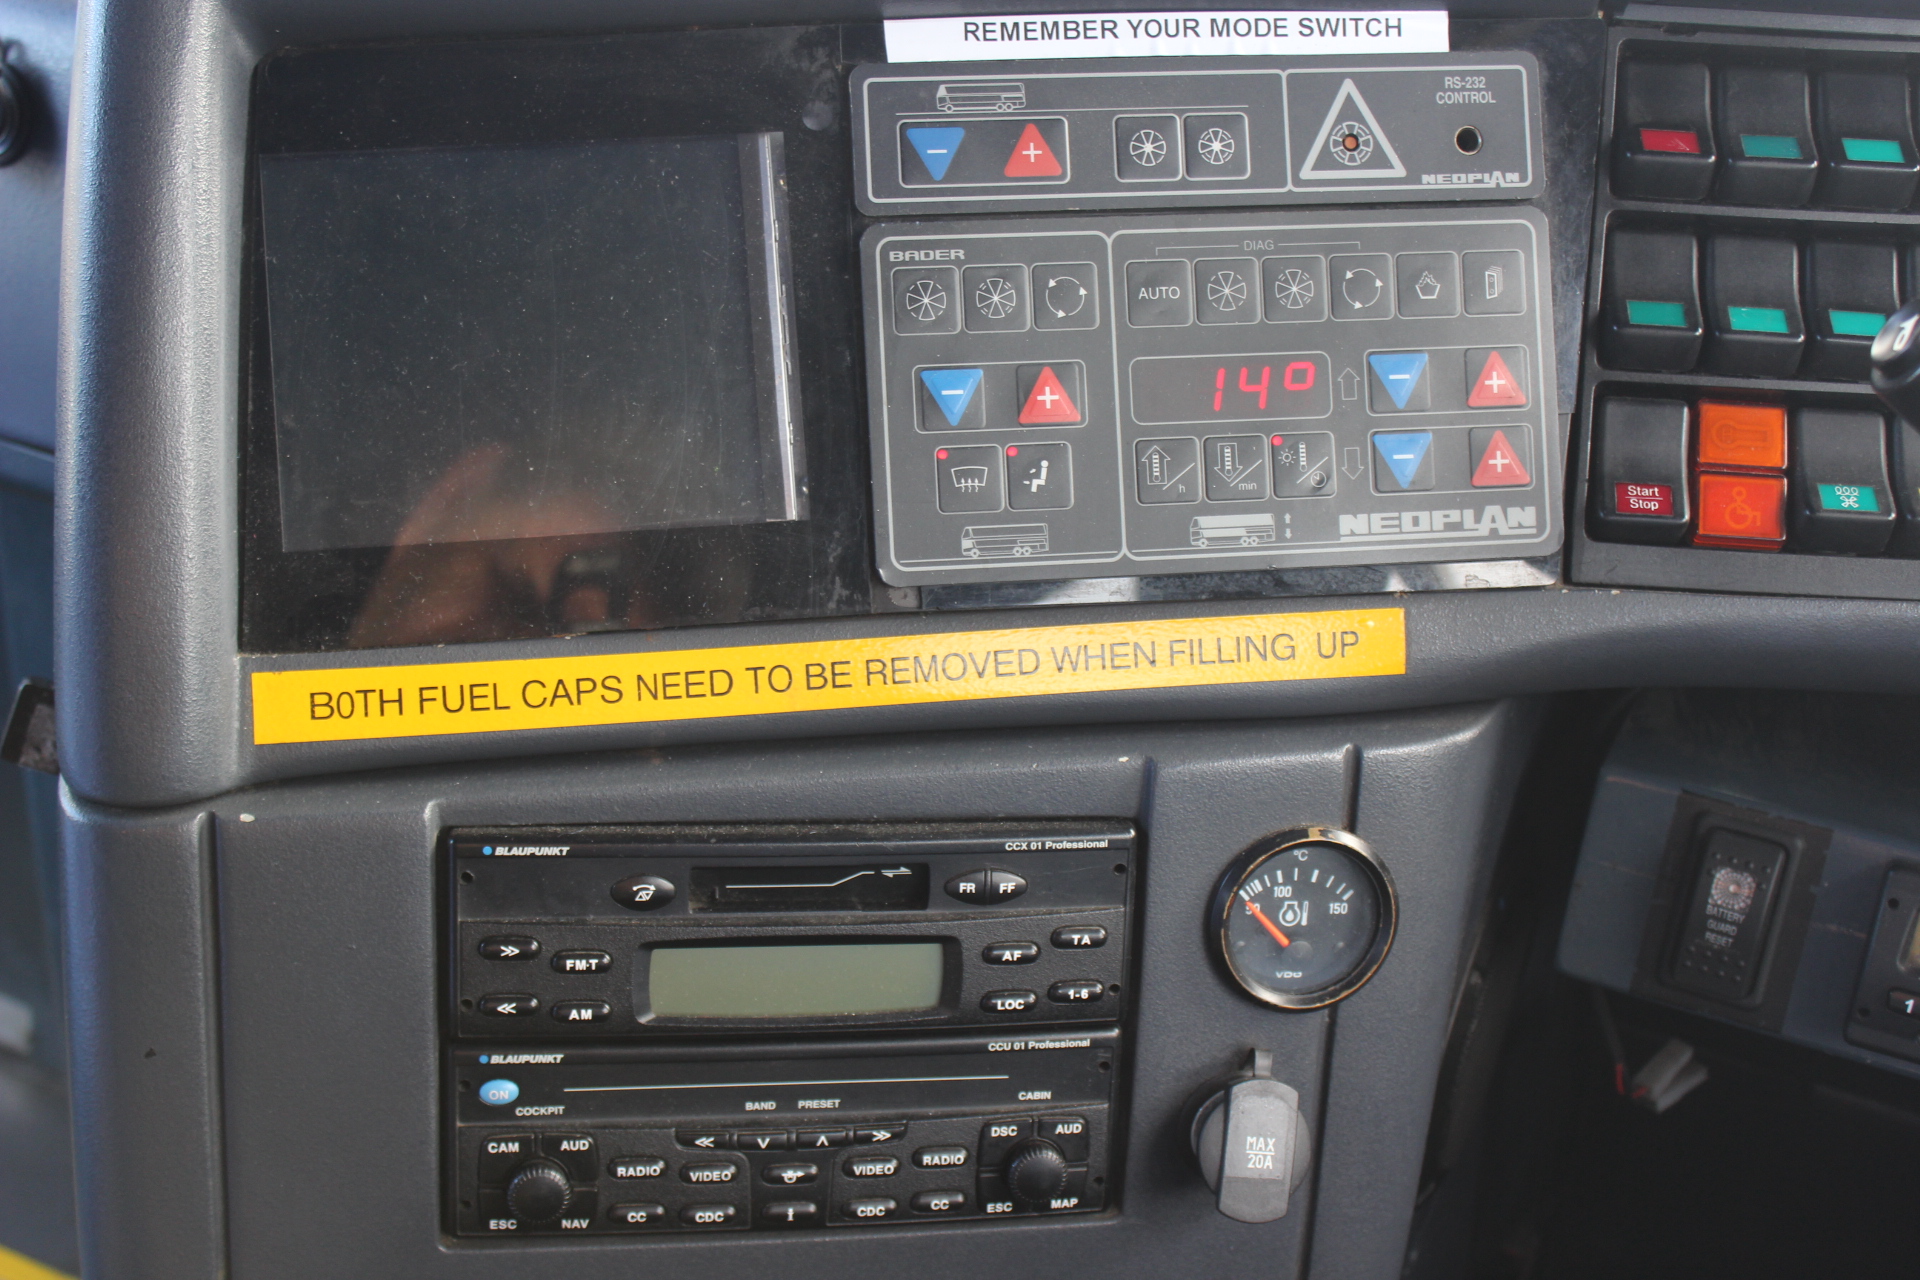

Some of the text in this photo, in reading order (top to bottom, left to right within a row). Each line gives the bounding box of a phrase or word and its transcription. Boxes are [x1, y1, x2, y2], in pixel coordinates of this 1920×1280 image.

[963, 17, 1402, 41] REMEMBER YOUR MODE SWITCH
[1444, 77, 1486, 89] RS-232
[1436, 91, 1496, 104] CONTROL
[1421, 171, 1519, 187] NEOPLAN
[1243, 240, 1274, 251] DIAG
[889, 249, 965, 262] BADER
[1138, 286, 1180, 300] AUTO
[1179, 483, 1185, 493] h
[1238, 480, 1257, 491] min
[1627, 485, 1660, 498] Start
[1630, 498, 1659, 511] Stop
[1339, 505, 1537, 535] NEOPLAN
[419, 683, 511, 715] FUEL
[522, 675, 623, 709] CAPS
[637, 669, 733, 702] NEED
[745, 664, 792, 693] TO
[805, 660, 852, 691] BE
[866, 648, 1041, 686] REMOVED
[1050, 641, 1156, 674] WHEN
[1169, 632, 1296, 667] FILLING
[1316, 630, 1360, 660] UP
[1005, 839, 1108, 851] CCX 01 Professional
[495, 846, 570, 856] BLAUPUNKT
[959, 882, 976, 894] FR
[999, 882, 1016, 893] FF
[1273, 886, 1292, 898] 100
[1329, 903, 1348, 915] 150
[1706, 904, 1746, 925] BATTERY
[1707, 919, 1738, 936] GUARD
[1072, 935, 1091, 946] TA
[1705, 931, 1734, 948] RESET
[1002, 951, 1022, 962] AF
[1275, 971, 1303, 979] VDO
[1068, 989, 1089, 1000] 1-6
[997, 1000, 1025, 1011] LOC
[1905, 999, 1915, 1014] 1
[568, 1009, 593, 1020] AM
[988, 1039, 1090, 1052] CCU 01 Professional
[490, 1054, 564, 1064] BLAUPUNKT
[489, 1090, 509, 1100] ON
[1018, 1091, 1052, 1101] CABIN
[745, 1101, 777, 1111] BAND
[798, 1100, 841, 1109] PRESET
[515, 1106, 565, 1117] COCKPIT
[991, 1126, 1018, 1137] DSC
[1055, 1123, 1082, 1135] AUD
[488, 1142, 519, 1154] CAM
[560, 1140, 589, 1151] AUD
[1246, 1136, 1276, 1150] MAX
[922, 1154, 965, 1166] RADIO
[1247, 1155, 1273, 1170] 20A
[617, 1165, 661, 1178] RADIO
[853, 1164, 894, 1176] VIDEO
[689, 1171, 732, 1182] VIDEO
[930, 1200, 949, 1211] CC
[987, 1203, 1013, 1213] ESC
[1051, 1198, 1078, 1209] MAP
[857, 1206, 886, 1217] CDC
[627, 1212, 647, 1223] CC
[695, 1212, 725, 1223] CDC
[489, 1219, 517, 1230] ESC
[561, 1219, 589, 1229] NAV
